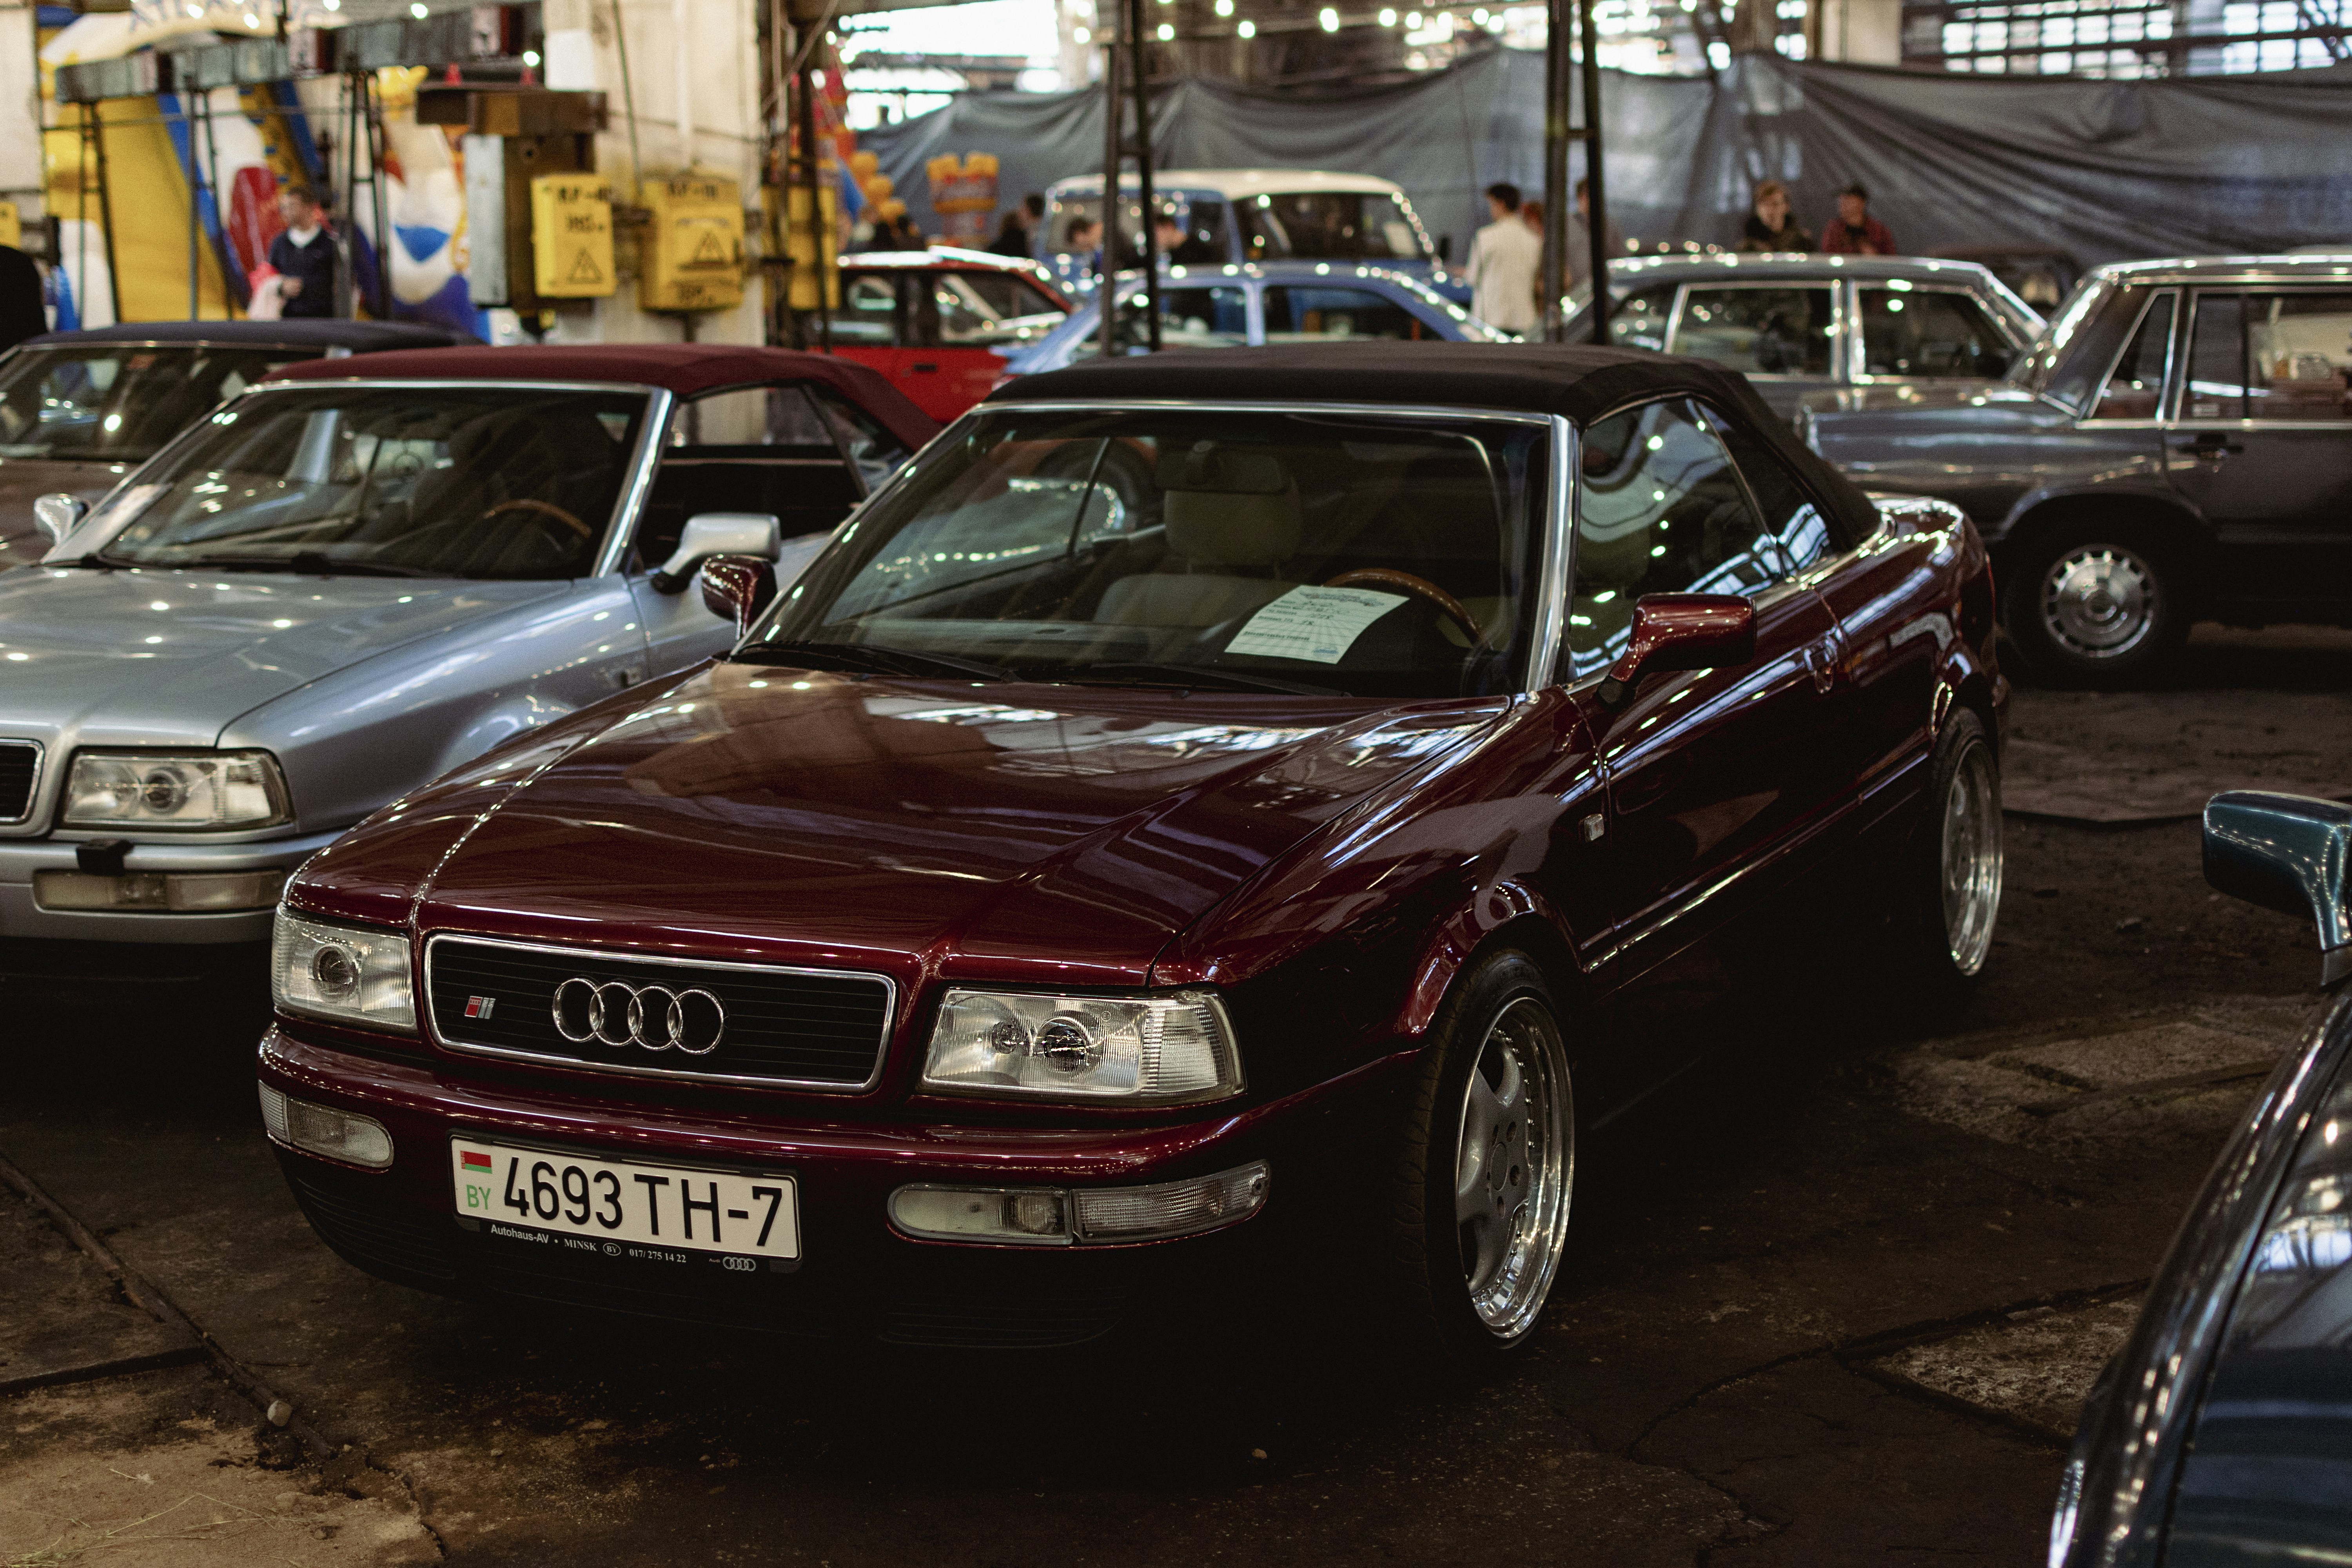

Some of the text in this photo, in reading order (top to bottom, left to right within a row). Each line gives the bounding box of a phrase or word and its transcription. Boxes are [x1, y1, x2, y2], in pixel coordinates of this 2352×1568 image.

[466, 1184, 491, 1210] BY
[504, 1157, 782, 1247] 4693 TH-7
[491, 1224, 549, 1244] Autohaus-AV
[564, 1238, 597, 1251] MINSK
[606, 1245, 617, 1253] BY
[648, 1250, 662, 1260] 275
[665, 1253, 674, 1262] 14
[677, 1254, 686, 1263] 22
